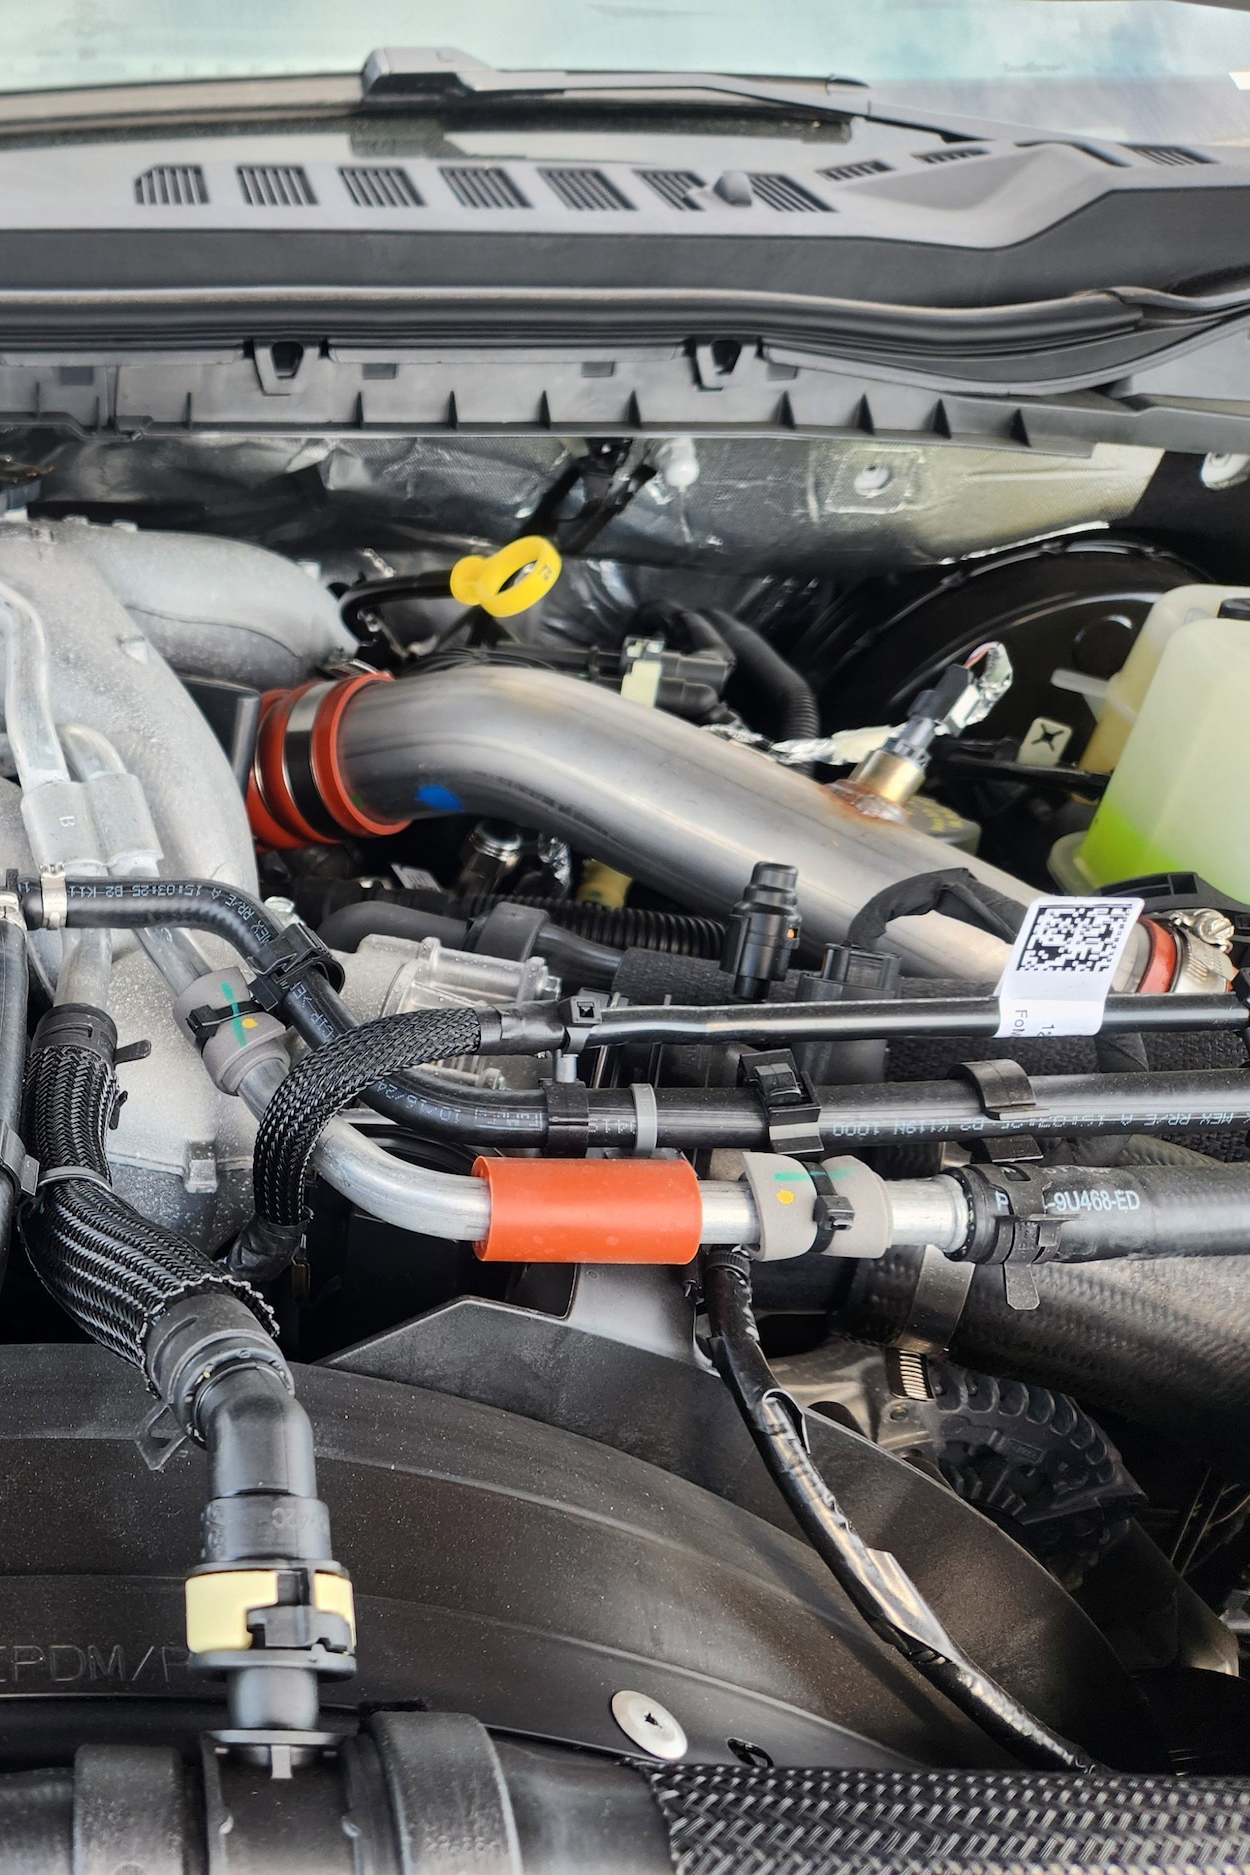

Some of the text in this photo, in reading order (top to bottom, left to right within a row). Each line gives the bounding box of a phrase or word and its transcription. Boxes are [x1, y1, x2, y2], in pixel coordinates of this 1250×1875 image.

[58, 815, 75, 828] B
[68, 885, 97, 898] K11
[105, 885, 124, 897] B2
[132, 883, 203, 898] 15:03:25
